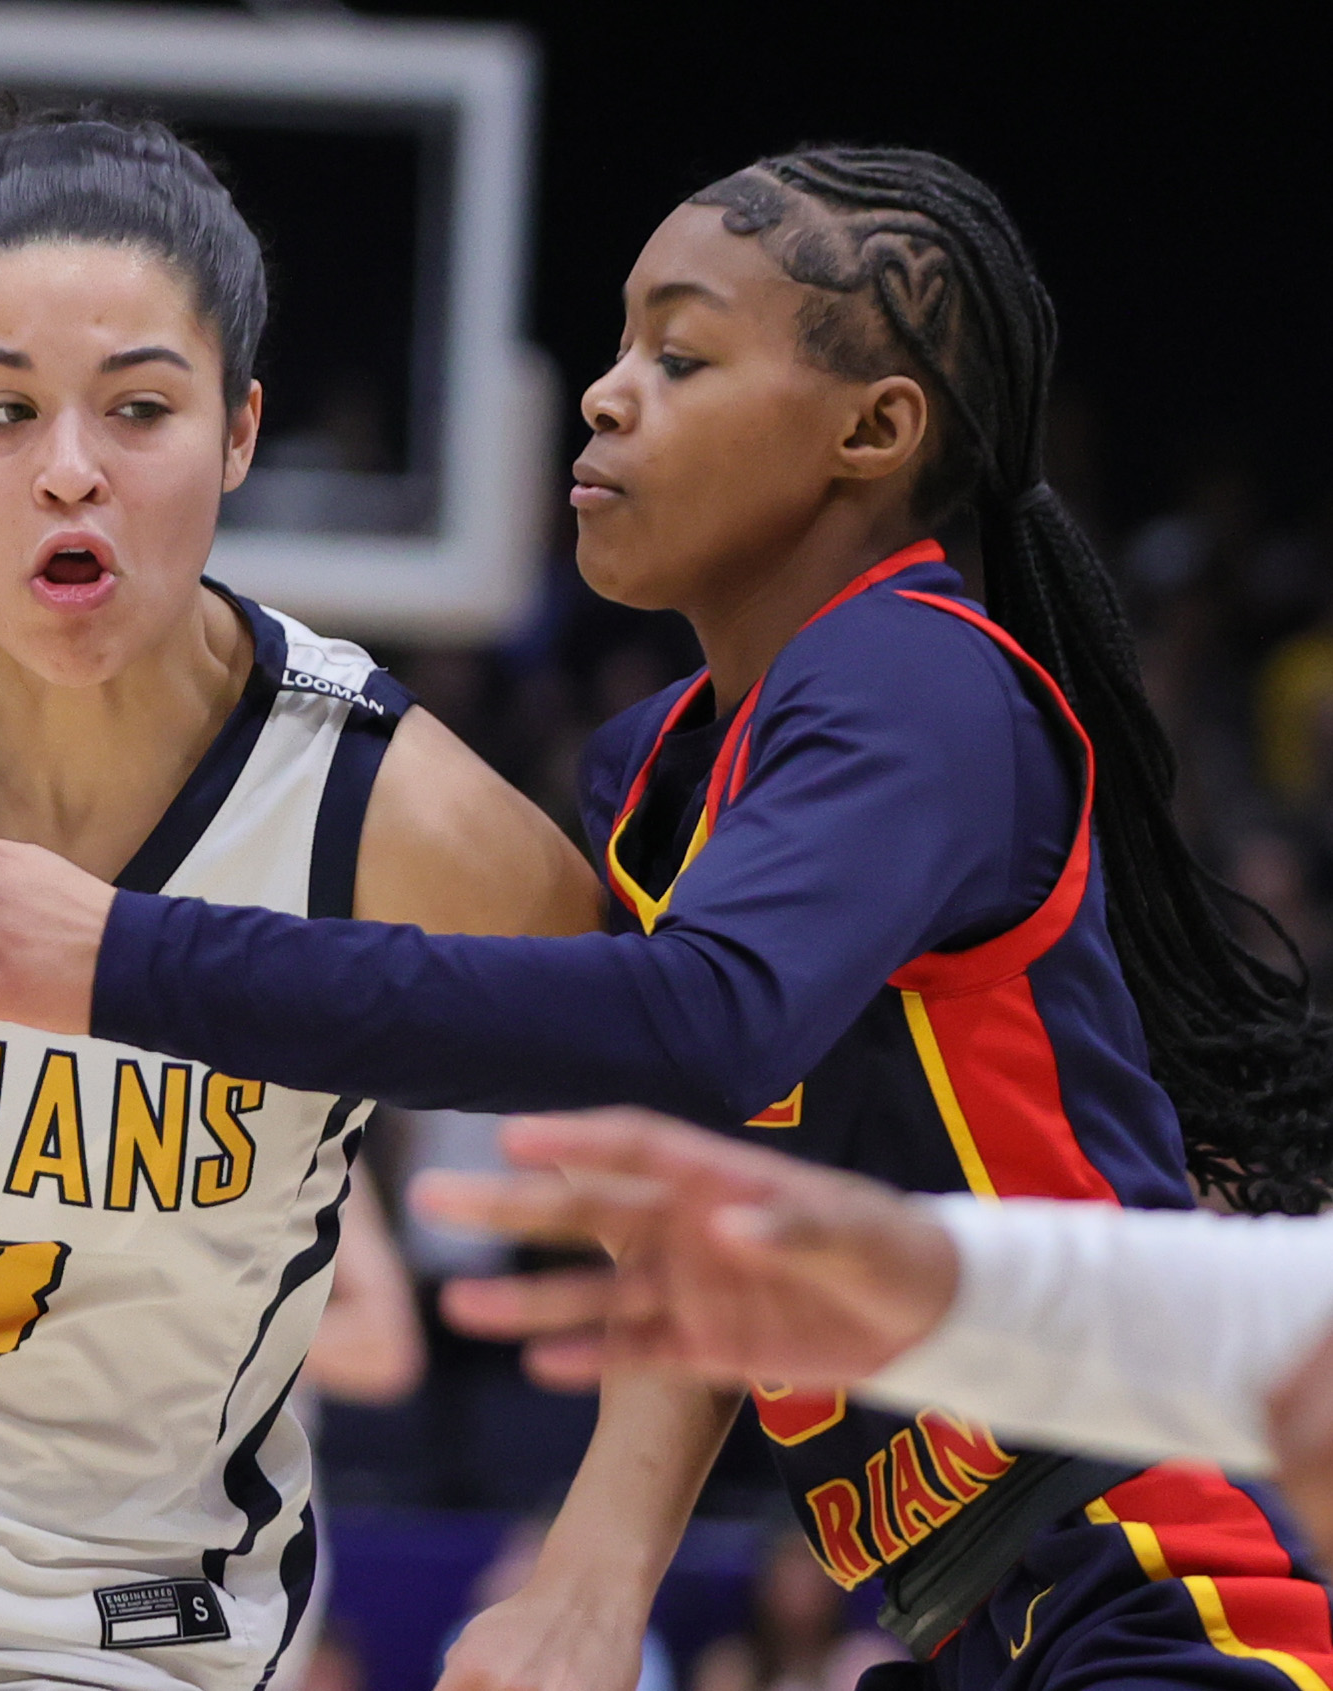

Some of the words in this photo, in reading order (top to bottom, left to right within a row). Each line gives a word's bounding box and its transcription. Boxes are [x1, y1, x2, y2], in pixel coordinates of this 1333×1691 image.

[281, 669, 385, 715] LOOMAN
[803, 1408, 1017, 1592] RIAN
[105, 1586, 173, 1604] ENGINEERED
[192, 1596, 210, 1622] S
